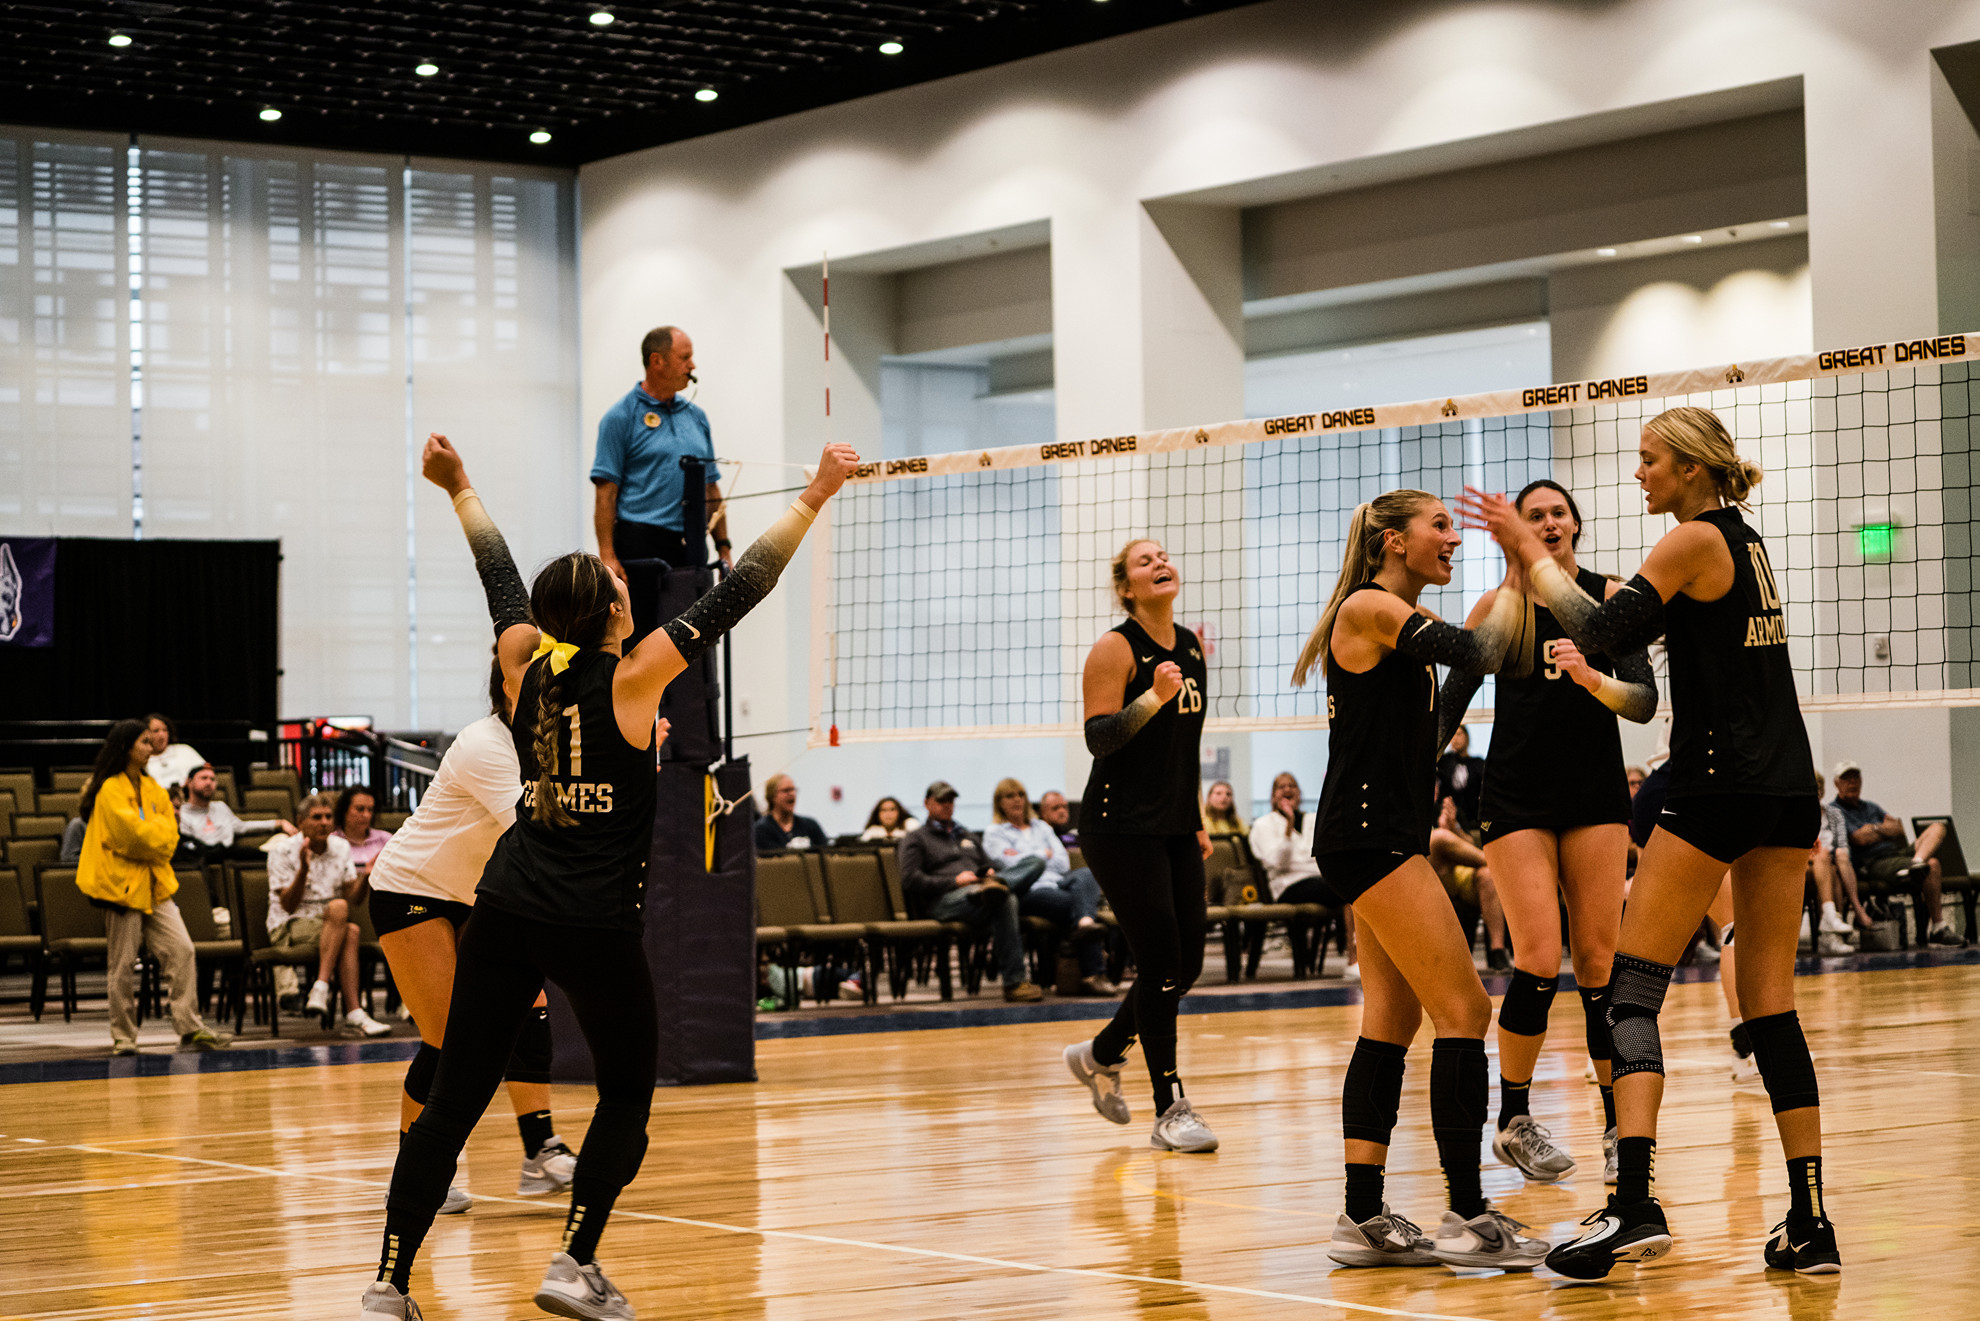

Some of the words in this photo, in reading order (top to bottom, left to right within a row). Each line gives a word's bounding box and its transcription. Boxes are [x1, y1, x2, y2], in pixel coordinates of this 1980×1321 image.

[1819, 344, 1887, 370] GREAT
[1894, 335, 1966, 363] DANES
[1522, 383, 1582, 407] GREAT
[1587, 375, 1649, 400] DANES
[1264, 414, 1317, 435] GREAT
[1321, 407, 1376, 429] DANES
[1041, 441, 1086, 460] GREAT
[1090, 435, 1137, 455] DANES
[886, 457, 928, 475] DANES
[1746, 542, 1781, 611] 10
[1543, 639, 1562, 680] 9
[1178, 677, 1202, 714] 26
[523, 779, 614, 813] GMES
